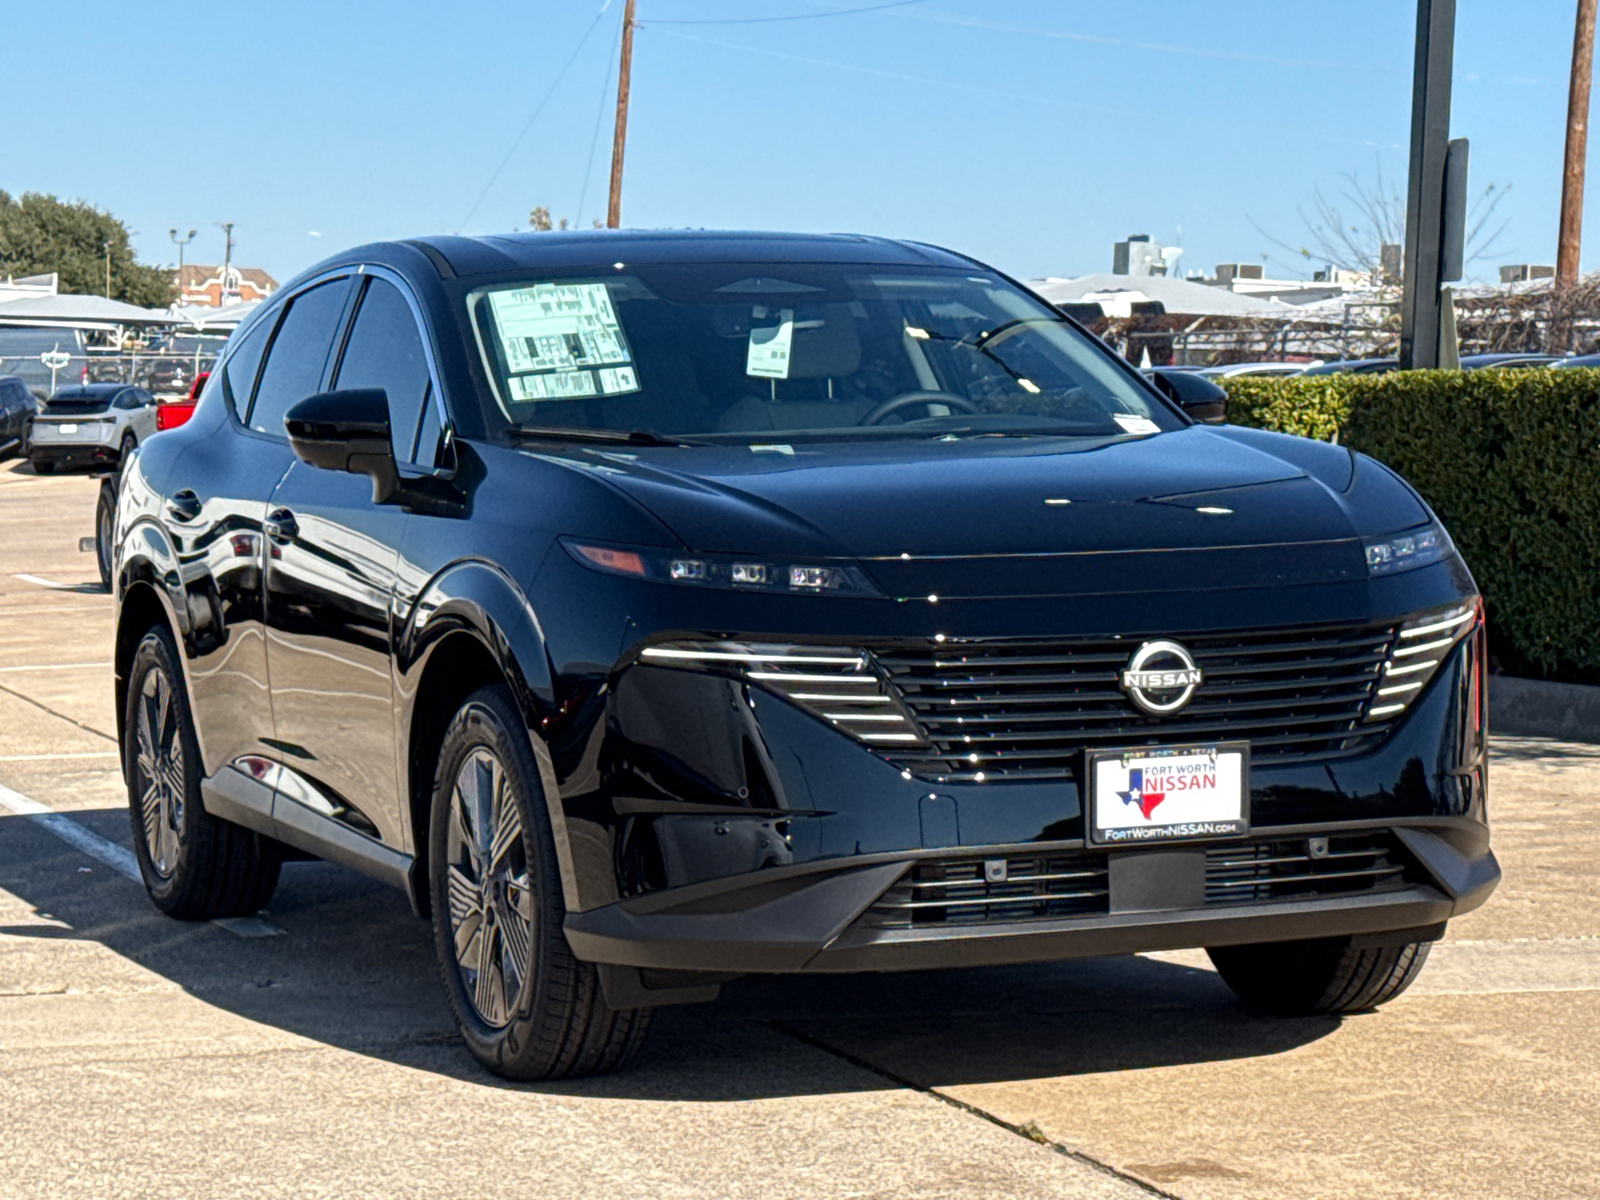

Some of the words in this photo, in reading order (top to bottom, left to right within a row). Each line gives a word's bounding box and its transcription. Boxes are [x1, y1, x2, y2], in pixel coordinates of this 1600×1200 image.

[1124, 671, 1201, 687] NISSAN
[1144, 765, 1173, 776] FORT
[1176, 763, 1216, 775] WORTH
[1144, 773, 1216, 793] NISSAN
